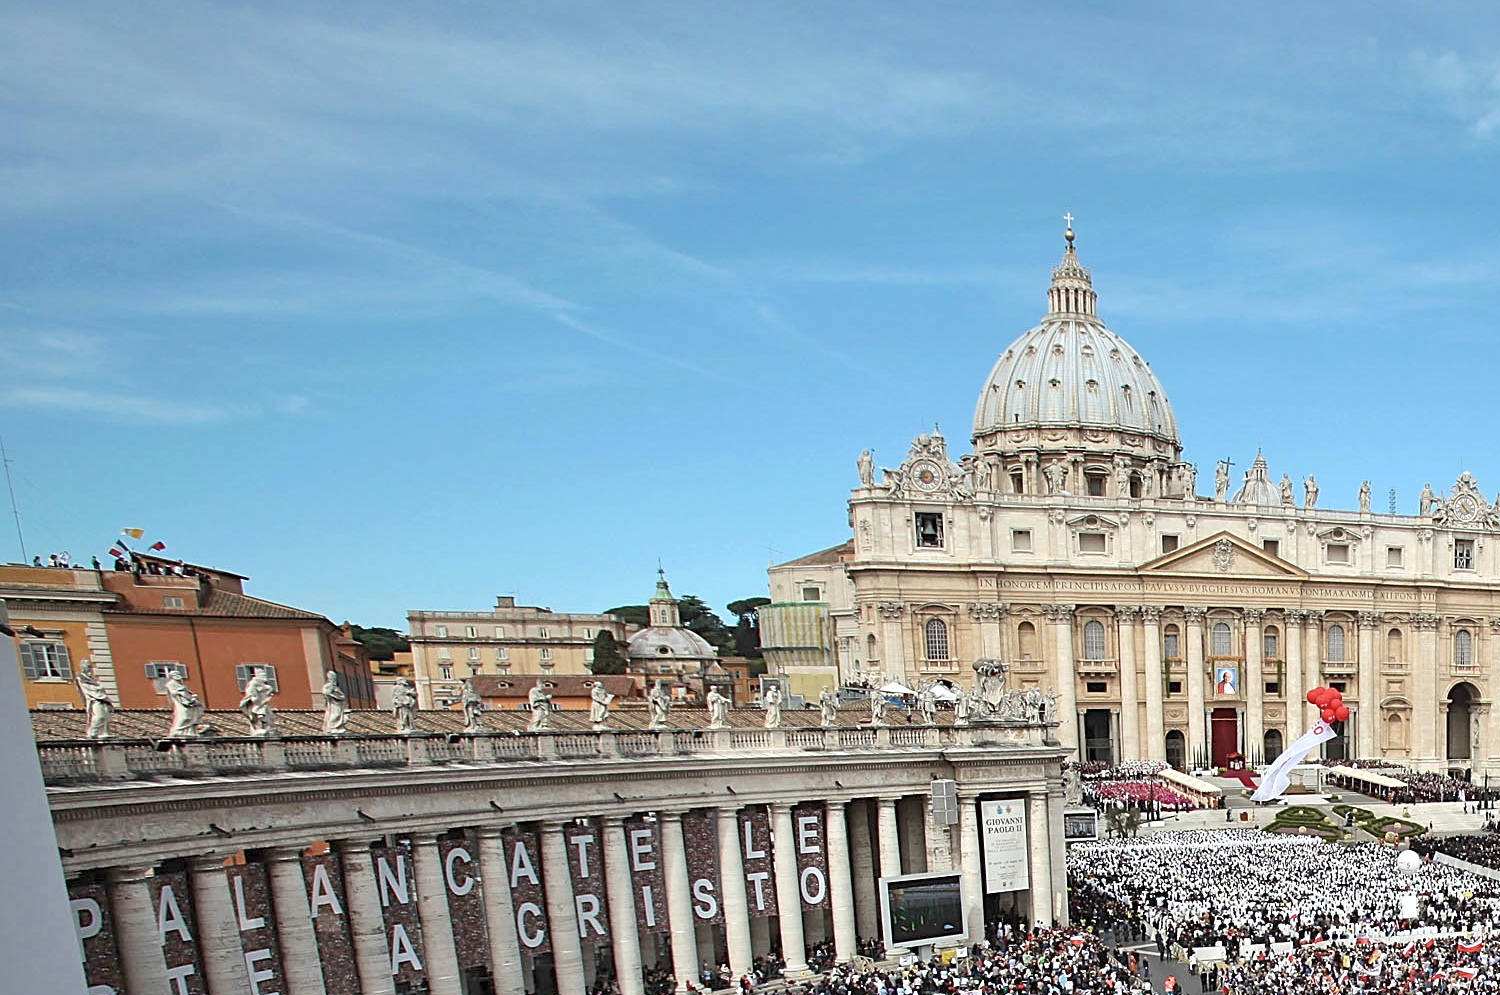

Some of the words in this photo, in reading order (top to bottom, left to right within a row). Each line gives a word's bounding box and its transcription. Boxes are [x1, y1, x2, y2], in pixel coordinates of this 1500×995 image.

[979, 579, 993, 588] IN
[997, 580, 1051, 589] HONOREM
[986, 817, 1023, 826] GIOVANNI
[988, 826, 1014, 834] PAOLO
[744, 816, 821, 861] LE
[391, 924, 422, 975] A
[517, 866, 826, 948] CRISTO
